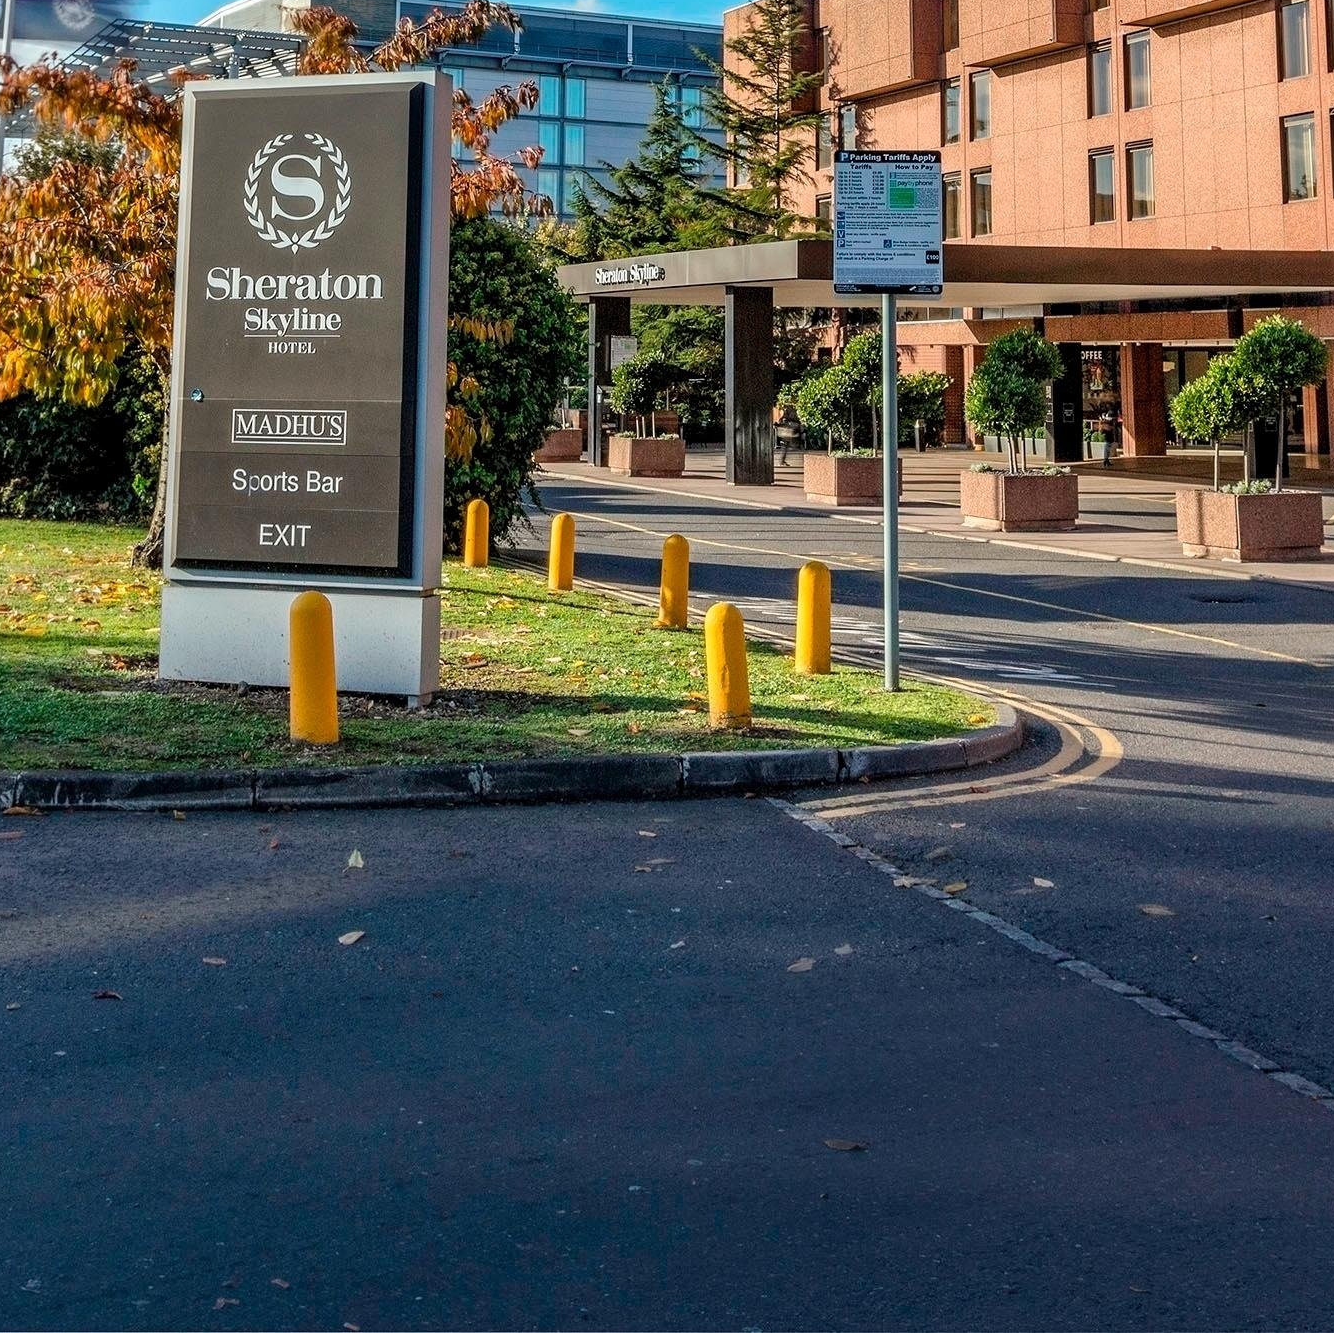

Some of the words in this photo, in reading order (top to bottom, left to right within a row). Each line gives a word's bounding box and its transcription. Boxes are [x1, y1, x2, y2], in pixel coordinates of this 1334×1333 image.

[850, 154, 881, 162] Parking
[912, 154, 936, 163] Apply
[271, 154, 325, 220] S
[206, 267, 384, 301] Sheraton
[595, 268, 628, 284] Sheraton
[630, 263, 660, 284] Skyline
[244, 307, 342, 337] Skyline
[268, 342, 316, 354] HOTEL
[1080, 350, 1103, 360] OFFEE
[236, 414, 343, 437] MADHU'S
[232, 468, 299, 497] Sports
[306, 470, 343, 494] Bar
[259, 523, 312, 547] EXIT
